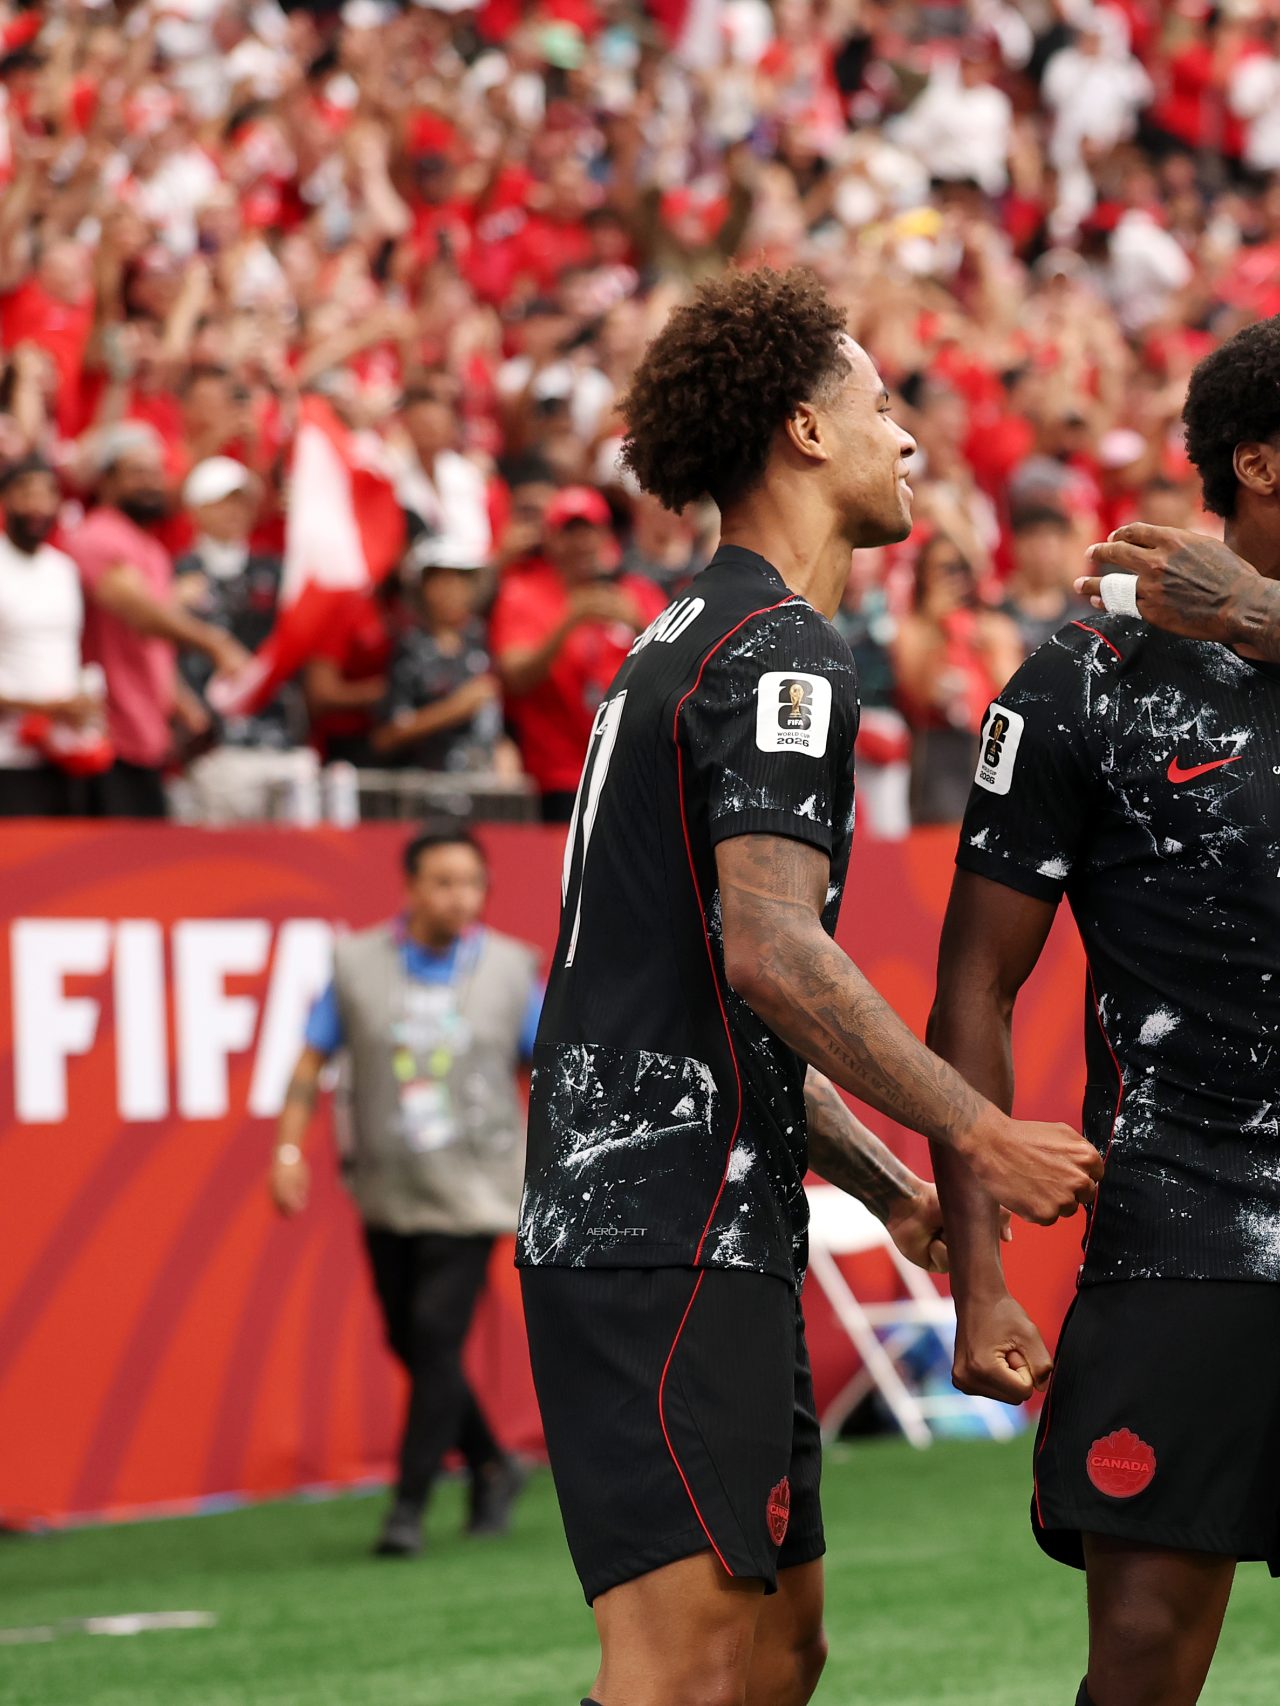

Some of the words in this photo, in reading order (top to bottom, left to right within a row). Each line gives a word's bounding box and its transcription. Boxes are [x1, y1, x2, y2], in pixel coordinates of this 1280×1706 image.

[777, 737, 809, 747] 2026
[980, 771, 995, 784] 2026
[586, 1227, 648, 1236] AERO-FIT
[1091, 1456, 1150, 1473] CANADA
